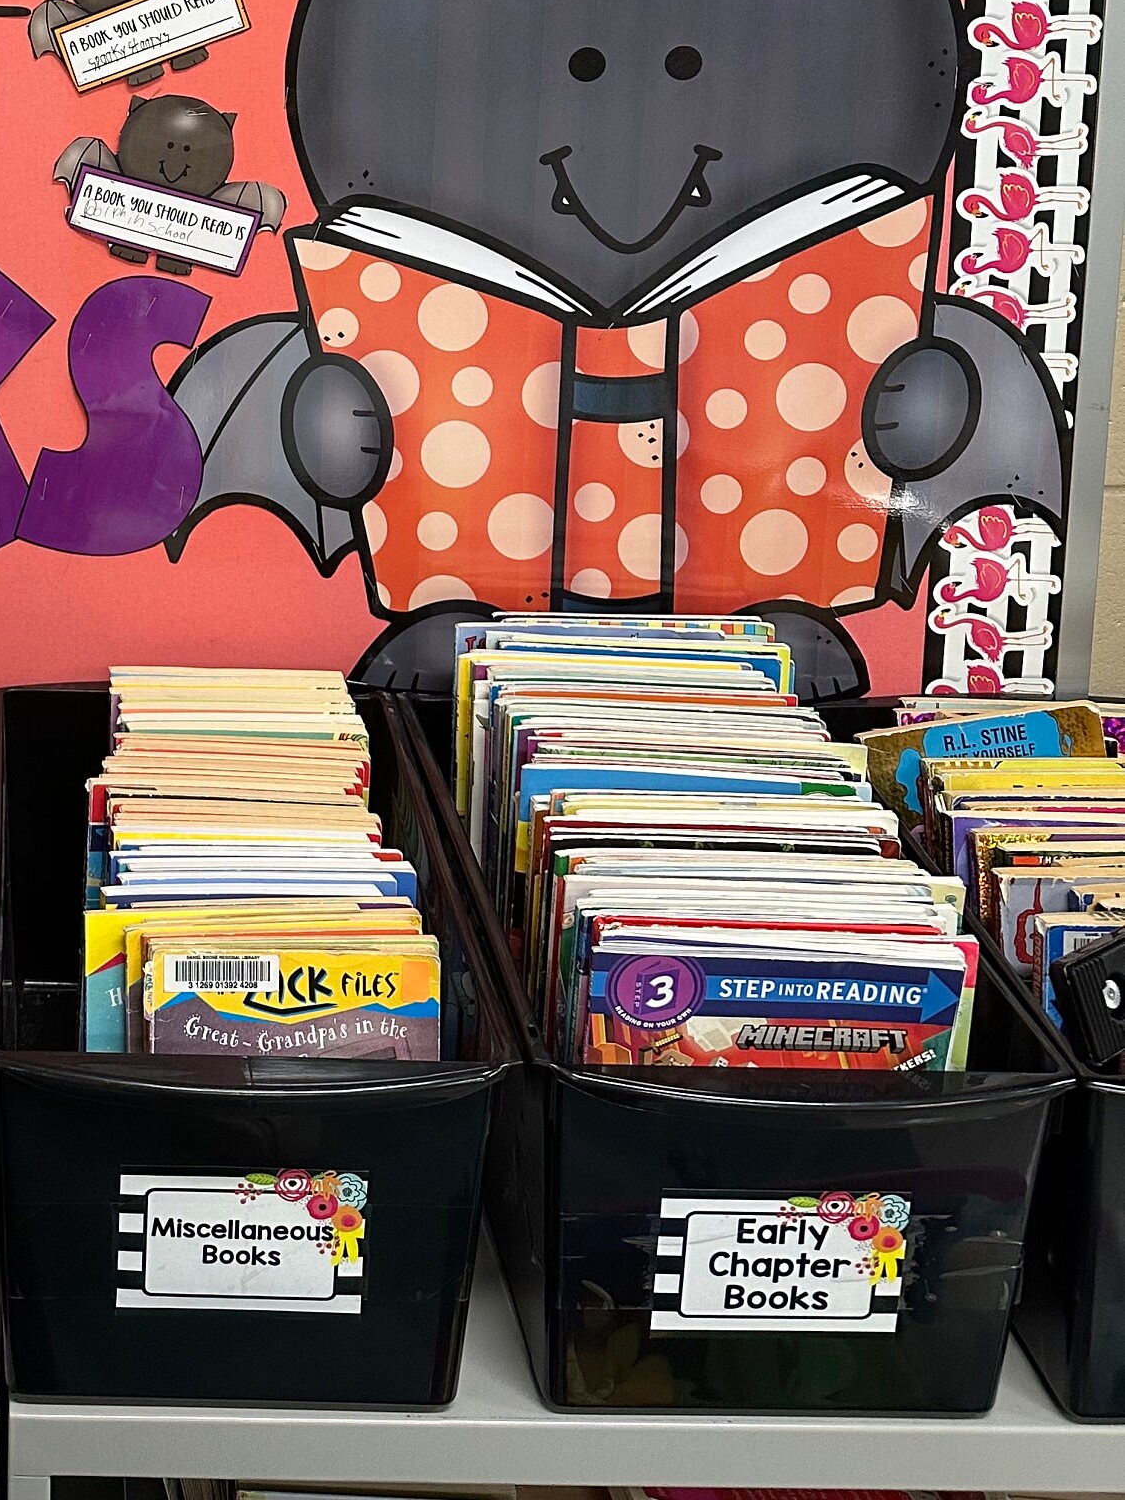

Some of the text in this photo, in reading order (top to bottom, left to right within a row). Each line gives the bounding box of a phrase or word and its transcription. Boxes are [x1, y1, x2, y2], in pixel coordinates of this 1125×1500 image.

[70, 40, 79, 55] A
[79, 29, 112, 51] BOOK
[112, 18, 137, 38] YOU
[137, 2, 181, 29] SHOULD
[980, 724, 1027, 746] STINE
[645, 975, 674, 1008] 3
[719, 979, 922, 1005] STEP INTO READING
[356, 1017, 374, 1035] in
[380, 1017, 408, 1040] the
[614, 1005, 641, 1027] READING
[656, 1018, 676, 1028] YOUR
[677, 1007, 692, 1021] OWN
[736, 1025, 908, 1053] MINECRAFT
[151, 1217, 335, 1242] Miscellaneous
[736, 1218, 830, 1251] Early
[202, 1244, 282, 1267] Books
[708, 1251, 852, 1284] Chapter
[723, 1284, 829, 1311] Books
